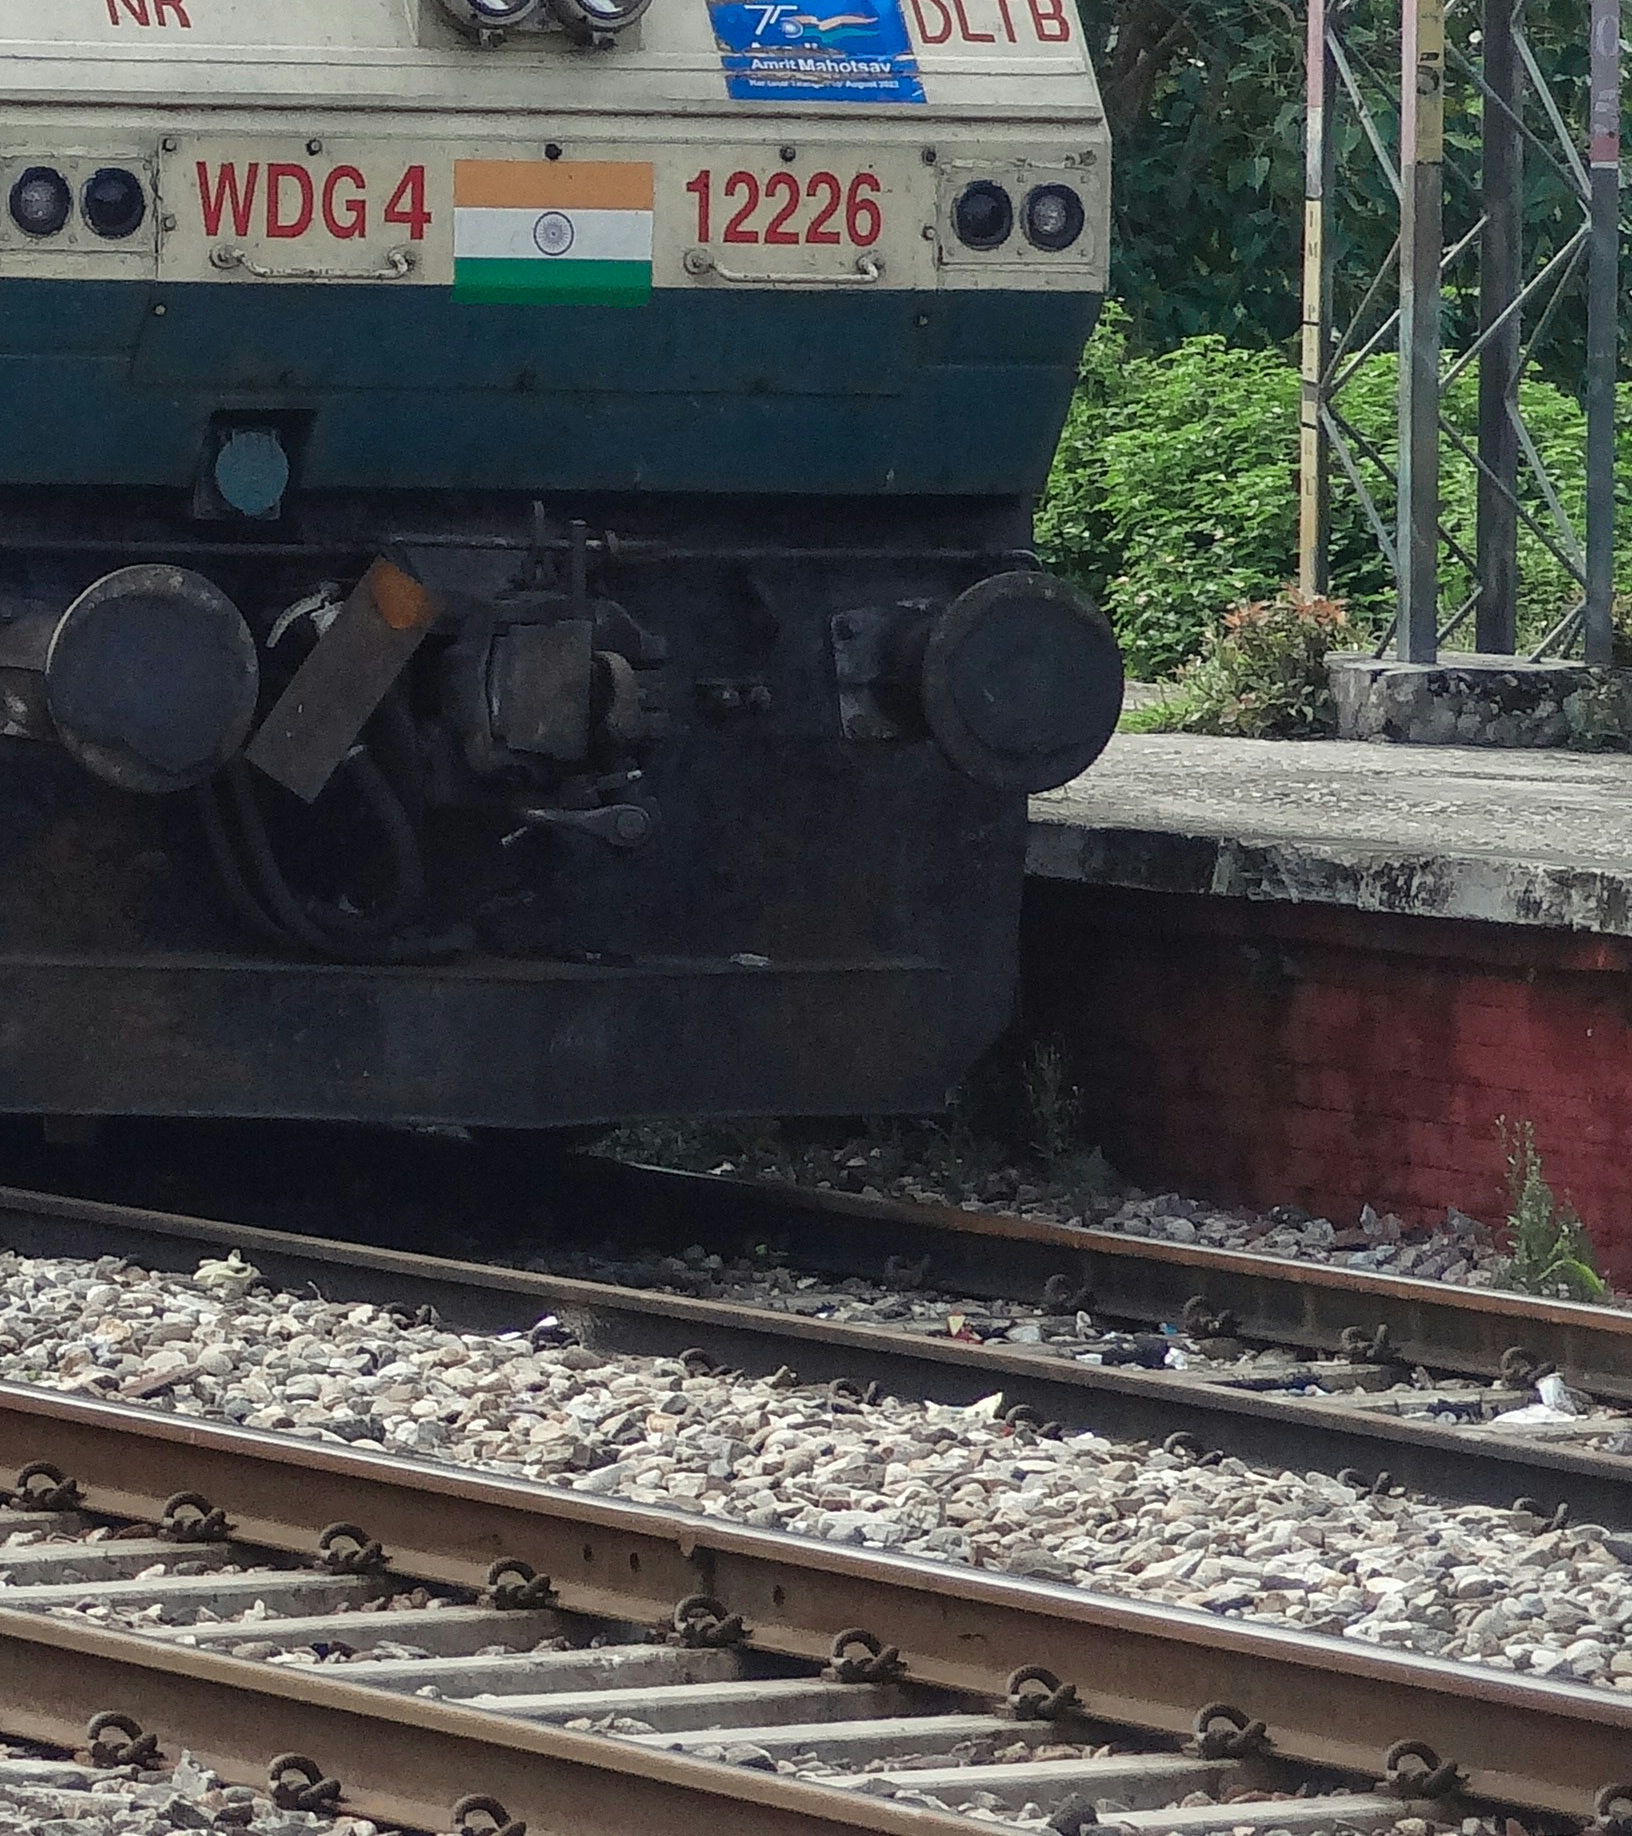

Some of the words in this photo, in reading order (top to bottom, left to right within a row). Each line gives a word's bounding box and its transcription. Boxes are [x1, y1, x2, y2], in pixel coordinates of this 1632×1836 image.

[751, 58, 797, 70] Amrit
[798, 58, 892, 74] Mahotsav
[686, 169, 882, 247] 12226
